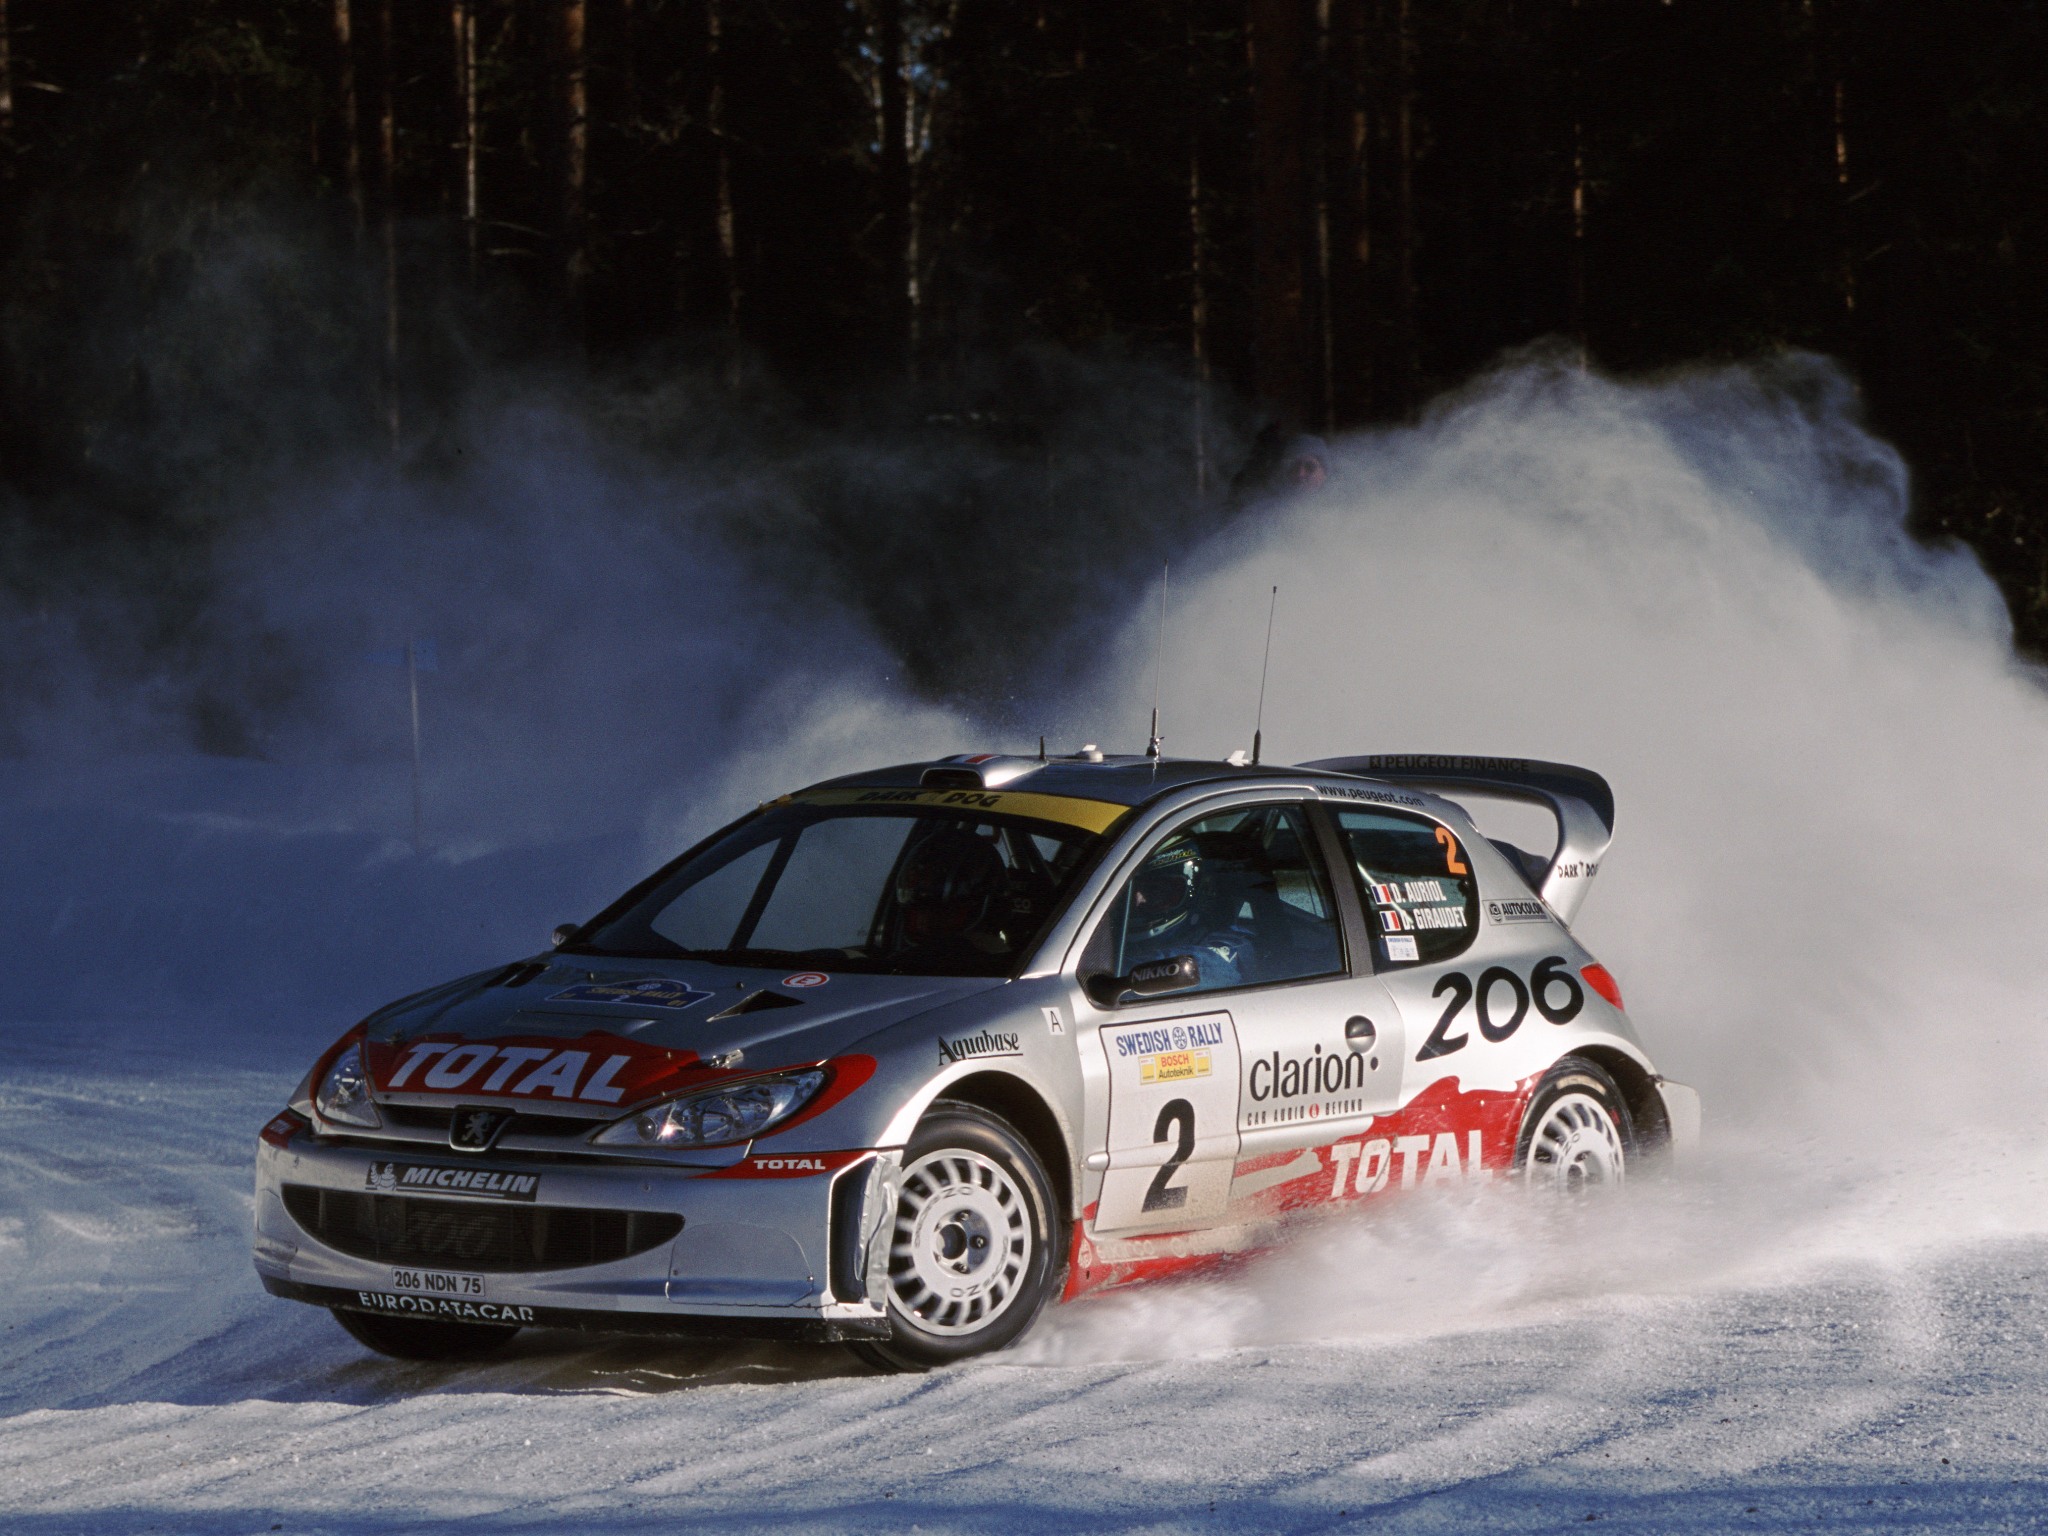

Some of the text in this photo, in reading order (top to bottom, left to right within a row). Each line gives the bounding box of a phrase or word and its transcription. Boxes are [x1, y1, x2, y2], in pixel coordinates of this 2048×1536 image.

[1385, 755, 1529, 772] PEUGEOT FINANCE
[943, 792, 1001, 808] DOG
[1316, 785, 1425, 807] www.peugeot.com
[1435, 826, 1467, 874] 2
[1557, 864, 1578, 878] DARK
[1390, 880, 1447, 903] D. AURIOL
[1412, 906, 1467, 930] GIRAUDET
[1131, 963, 1180, 982] NIKKO
[1416, 956, 1584, 1062] 206
[1049, 1010, 1063, 1032] A
[938, 1029, 1021, 1066] Aquabase
[1115, 1022, 1224, 1057] SWEDISH RALLY
[1160, 1053, 1190, 1067] BOSCH
[387, 1042, 632, 1103] TOTAL
[1158, 1066, 1194, 1079] Autoteknik
[1247, 1111, 1267, 1126] CAR
[1274, 1105, 1304, 1122] AUDIO
[1325, 1098, 1363, 1115] BEYOND
[753, 1159, 826, 1170] TOTAL
[1141, 1098, 1196, 1213] 2
[1330, 1129, 1494, 1198] TOTAL
[402, 1167, 537, 1193] MICHELIN
[394, 1271, 481, 1294] 206 NDN 75
[358, 1291, 534, 1322] EURODATACAR
